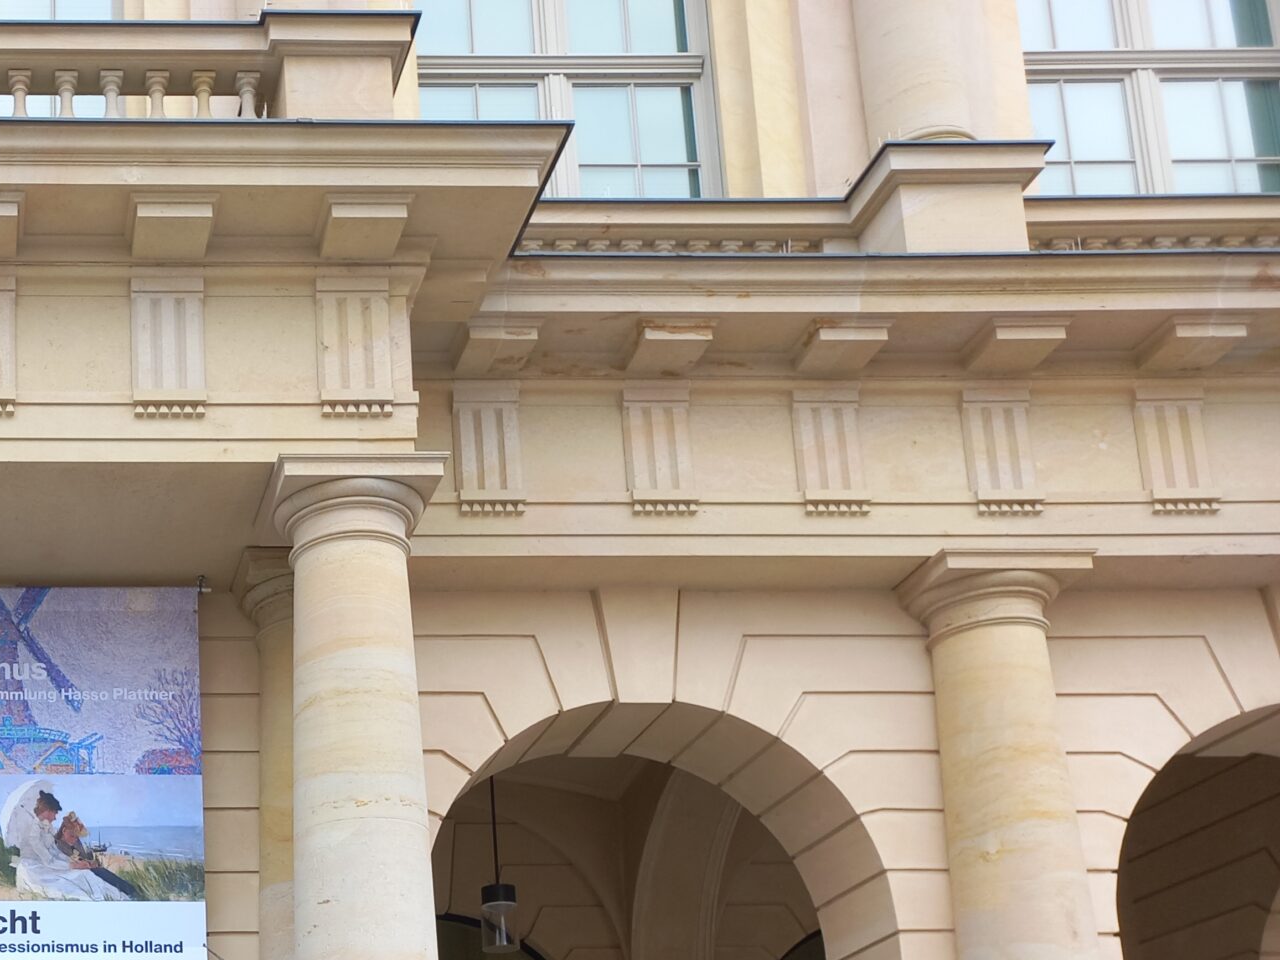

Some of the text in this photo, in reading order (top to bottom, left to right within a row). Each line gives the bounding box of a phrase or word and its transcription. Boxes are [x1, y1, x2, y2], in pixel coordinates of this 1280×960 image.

[61, 688, 108, 701] Hasso
[113, 688, 175, 701] Plattner
[103, 940, 117, 954] in
[122, 940, 184, 954] Holland
